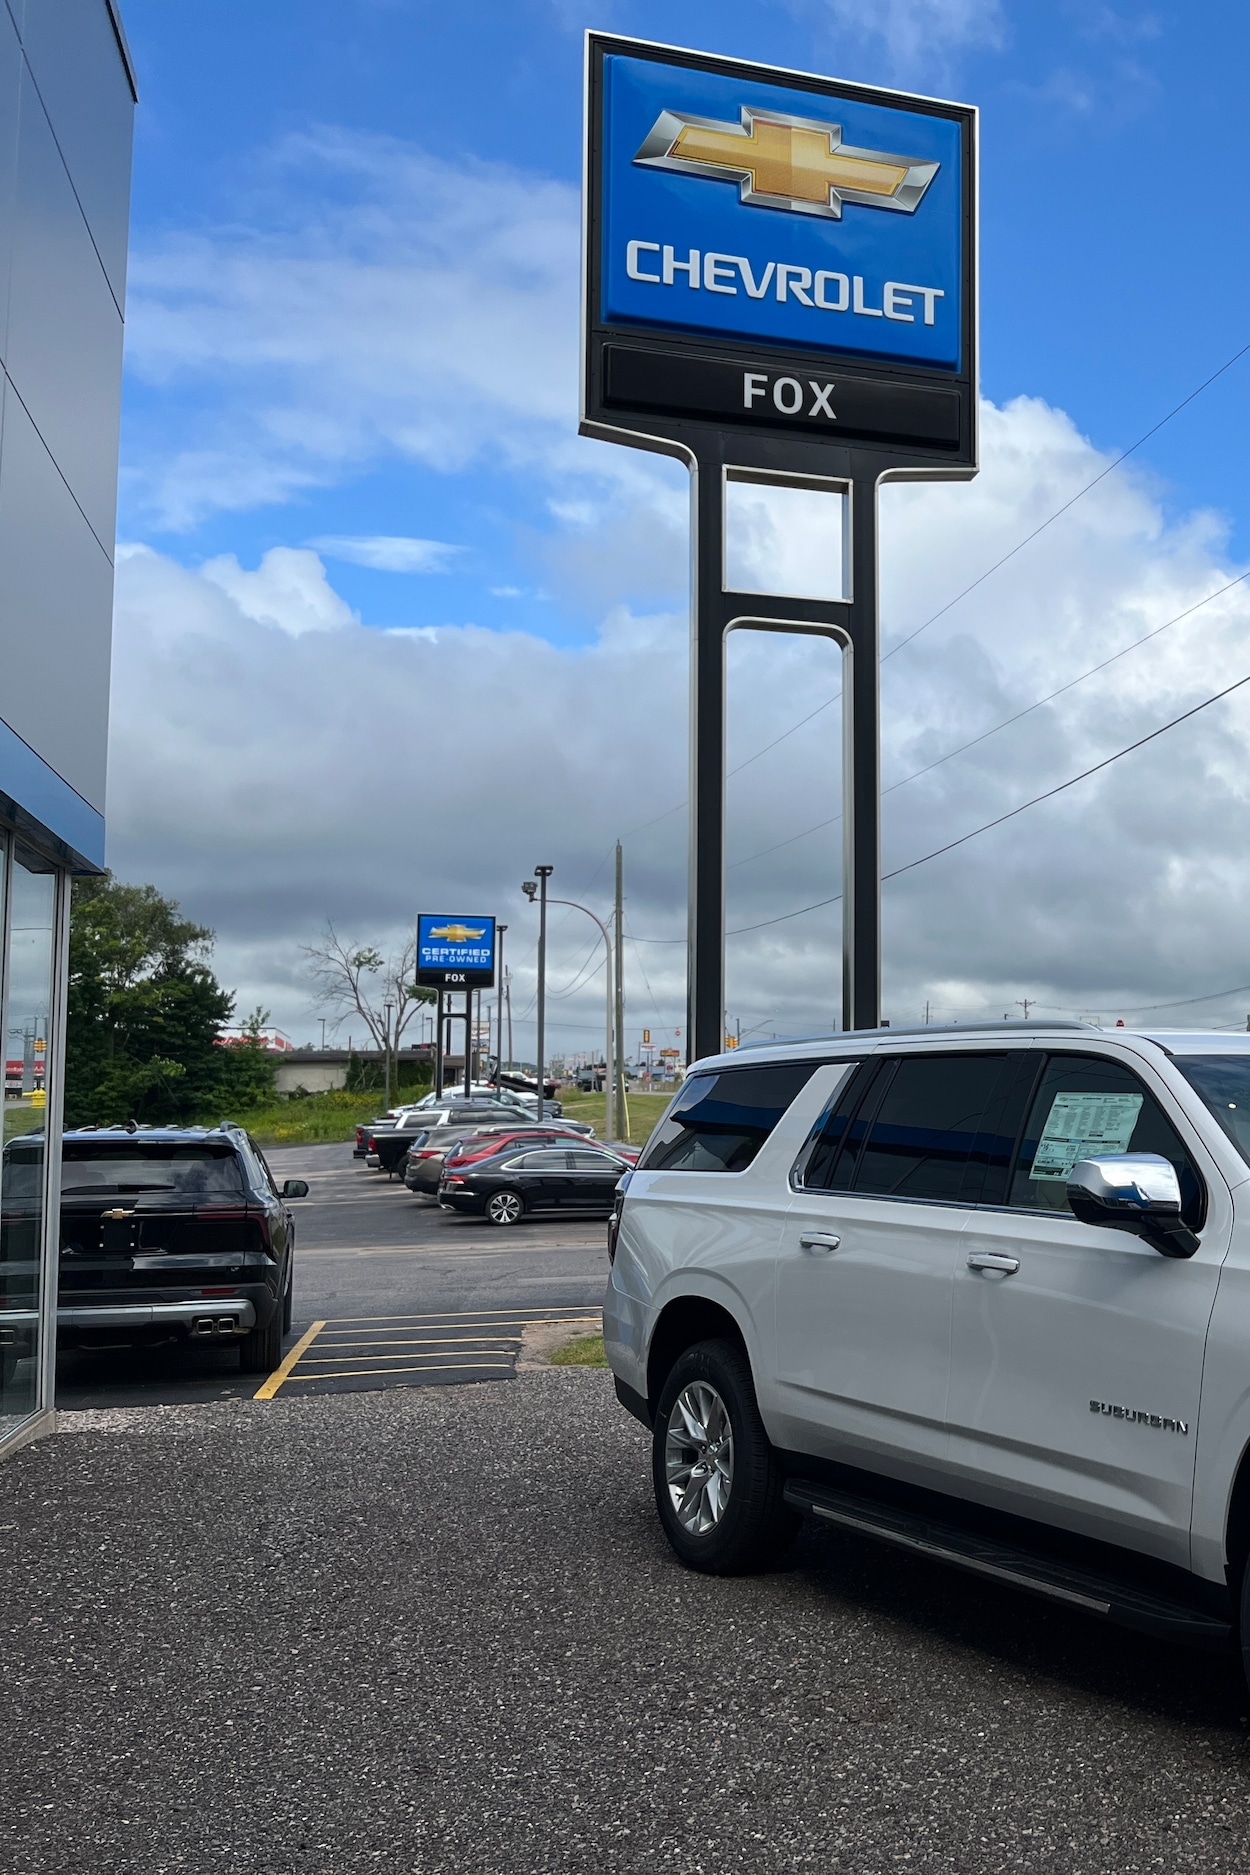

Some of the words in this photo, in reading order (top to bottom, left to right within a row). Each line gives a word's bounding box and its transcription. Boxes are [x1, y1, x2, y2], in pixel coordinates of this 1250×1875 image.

[626, 240, 944, 325] CHEVROLET
[743, 372, 837, 420] FOX
[421, 947, 491, 956] CERTIFIED
[425, 955, 487, 963] PRE-OWNED
[445, 973, 466, 982] FOX
[1089, 1399, 1189, 1436] SUBURBAN
